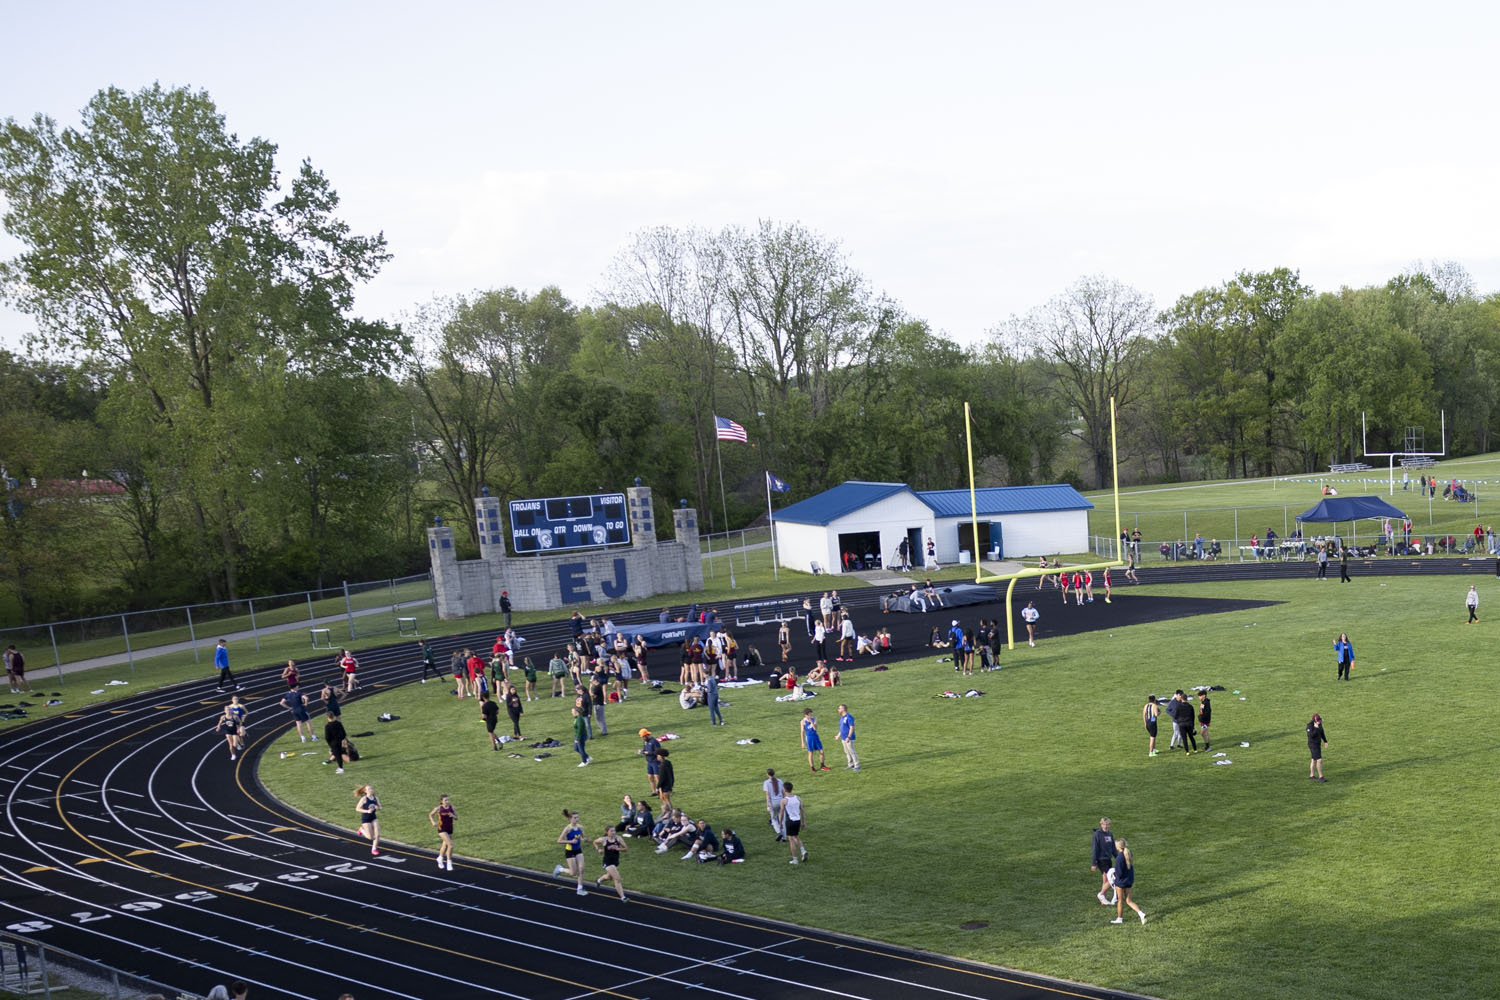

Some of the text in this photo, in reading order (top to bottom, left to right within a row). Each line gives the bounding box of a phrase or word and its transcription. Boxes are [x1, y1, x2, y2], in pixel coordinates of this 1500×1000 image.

[600, 496, 623, 505] VISITOR
[512, 502, 541, 512] TROJANS
[554, 526, 566, 535] QTR
[573, 523, 593, 533] DOWN
[606, 521, 624, 530] TO GO
[514, 528, 541, 538] BALL ON
[557, 558, 628, 604] EJ
[5, 854, 407, 933] 1 2 3 4 5 6 7 8
